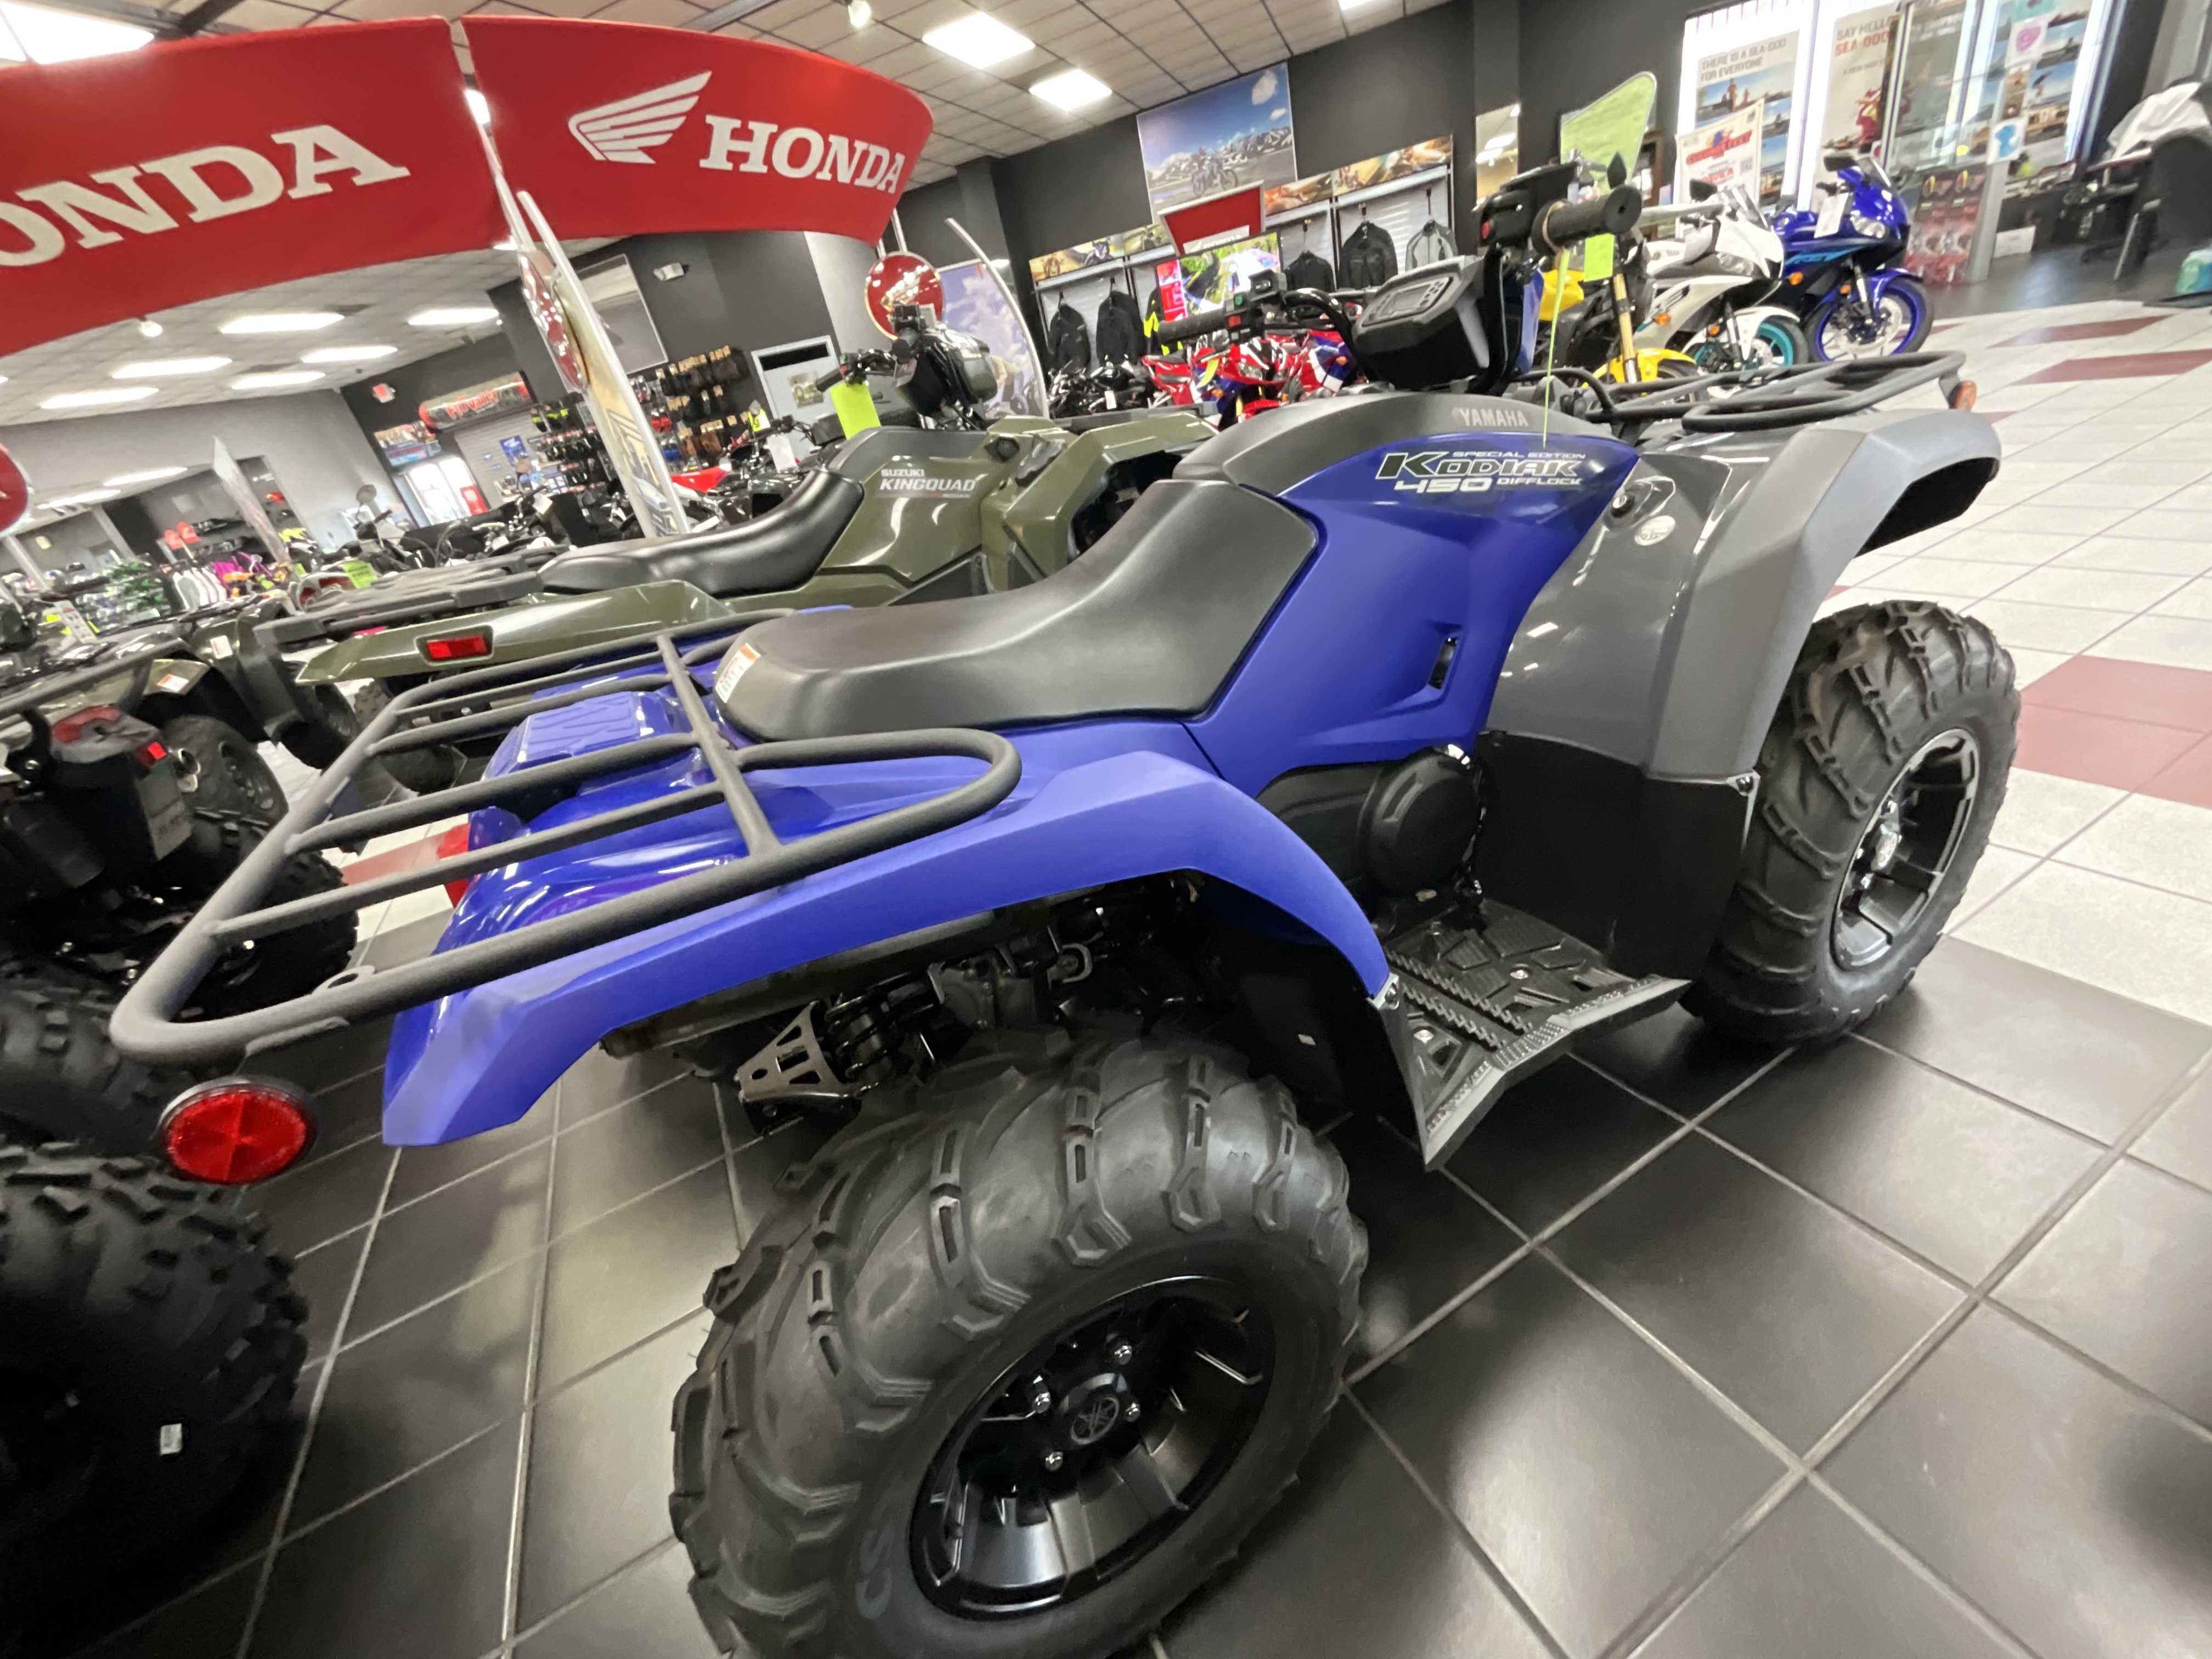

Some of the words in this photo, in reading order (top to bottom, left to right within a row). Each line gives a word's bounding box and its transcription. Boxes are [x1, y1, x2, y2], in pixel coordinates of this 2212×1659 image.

[1701, 68, 1717, 82] FOR
[1718, 55, 1763, 78] EVERYONE
[1702, 54, 1728, 70] THERE
[699, 114, 906, 194] HONDA
[1458, 408, 1528, 427] YAMAHA
[881, 469, 925, 477] SUZUKI
[879, 478, 978, 492] KINGQUAD
[1393, 477, 1493, 494] 450
[1496, 477, 1582, 486] DIFFLOCK
